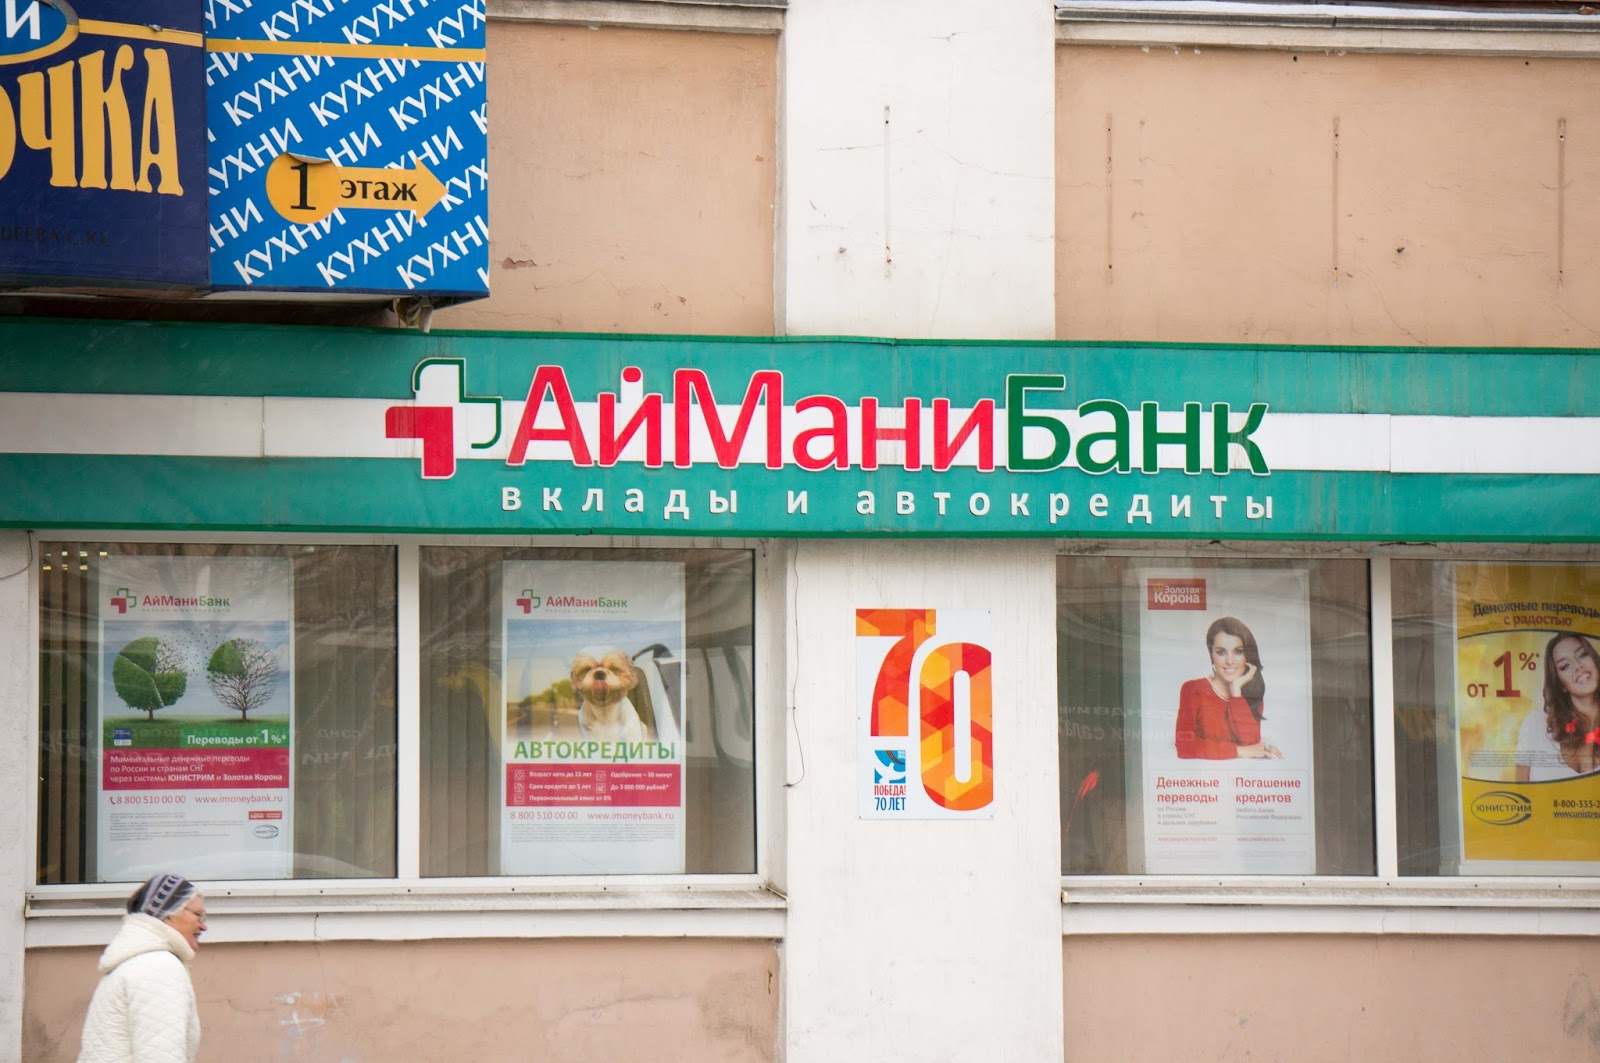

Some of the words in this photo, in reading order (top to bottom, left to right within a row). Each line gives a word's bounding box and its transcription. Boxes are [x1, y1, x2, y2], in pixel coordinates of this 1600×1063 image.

[208, 117, 304, 196] УХНИ
[290, 162, 317, 210] 1
[340, 179, 418, 202] этаж
[396, 214, 489, 290] КУХН
[505, 364, 1271, 477] АйМаниБанк
[501, 486, 738, 520] вклады
[786, 490, 808, 514] и
[857, 489, 1274, 525] автокредиты
[1164, 585, 1200, 594] Золотая
[142, 595, 230, 607] АйМаниБанк
[546, 596, 628, 608] АйМаниБанк
[1154, 593, 1200, 605] Корона
[1473, 602, 1538, 618] Денежные
[1503, 615, 1510, 625] с
[1513, 615, 1573, 627] радостью
[1466, 683, 1489, 698] от
[855, 608, 994, 812] 70
[187, 735, 244, 746] Переводы
[245, 736, 258, 745] от
[513, 740, 675, 763] АВТОКРЕДИТЫ
[110, 755, 170, 764] Моментальные
[171, 756, 212, 765] денежные
[212, 755, 250, 764] переводы
[110, 766, 120, 774] по
[121, 765, 149, 773] России
[157, 765, 188, 774] странам
[190, 764, 204, 773] СНГ
[110, 776, 132, 784] через
[133, 775, 167, 783] системы
[168, 773, 215, 782] ЮНИСТРИМ
[222, 773, 253, 782] Золотая
[254, 773, 283, 783] Корона
[1156, 776, 1220, 790] Денежные
[1235, 776, 1301, 789] Погашение
[873, 783, 907, 797] ПОБЕДА!
[117, 796, 123, 805] 8
[124, 796, 141, 805] 800
[143, 796, 160, 805] 510
[161, 796, 174, 804] 00
[175, 795, 187, 804] 00
[194, 794, 283, 805] www.imoneybank.ru
[874, 797, 888, 811] 70
[887, 797, 906, 811] ЛЕТ
[1156, 793, 1218, 805] переводы
[1235, 793, 1292, 805] кредитов
[1476, 804, 1532, 813] ЮНИСТРИМ
[510, 812, 516, 820] 8
[518, 812, 534, 820] 800
[537, 812, 551, 820] 510
[554, 812, 566, 820] 00
[567, 812, 579, 820] 00
[587, 811, 675, 821] www.imoneybank.ru
